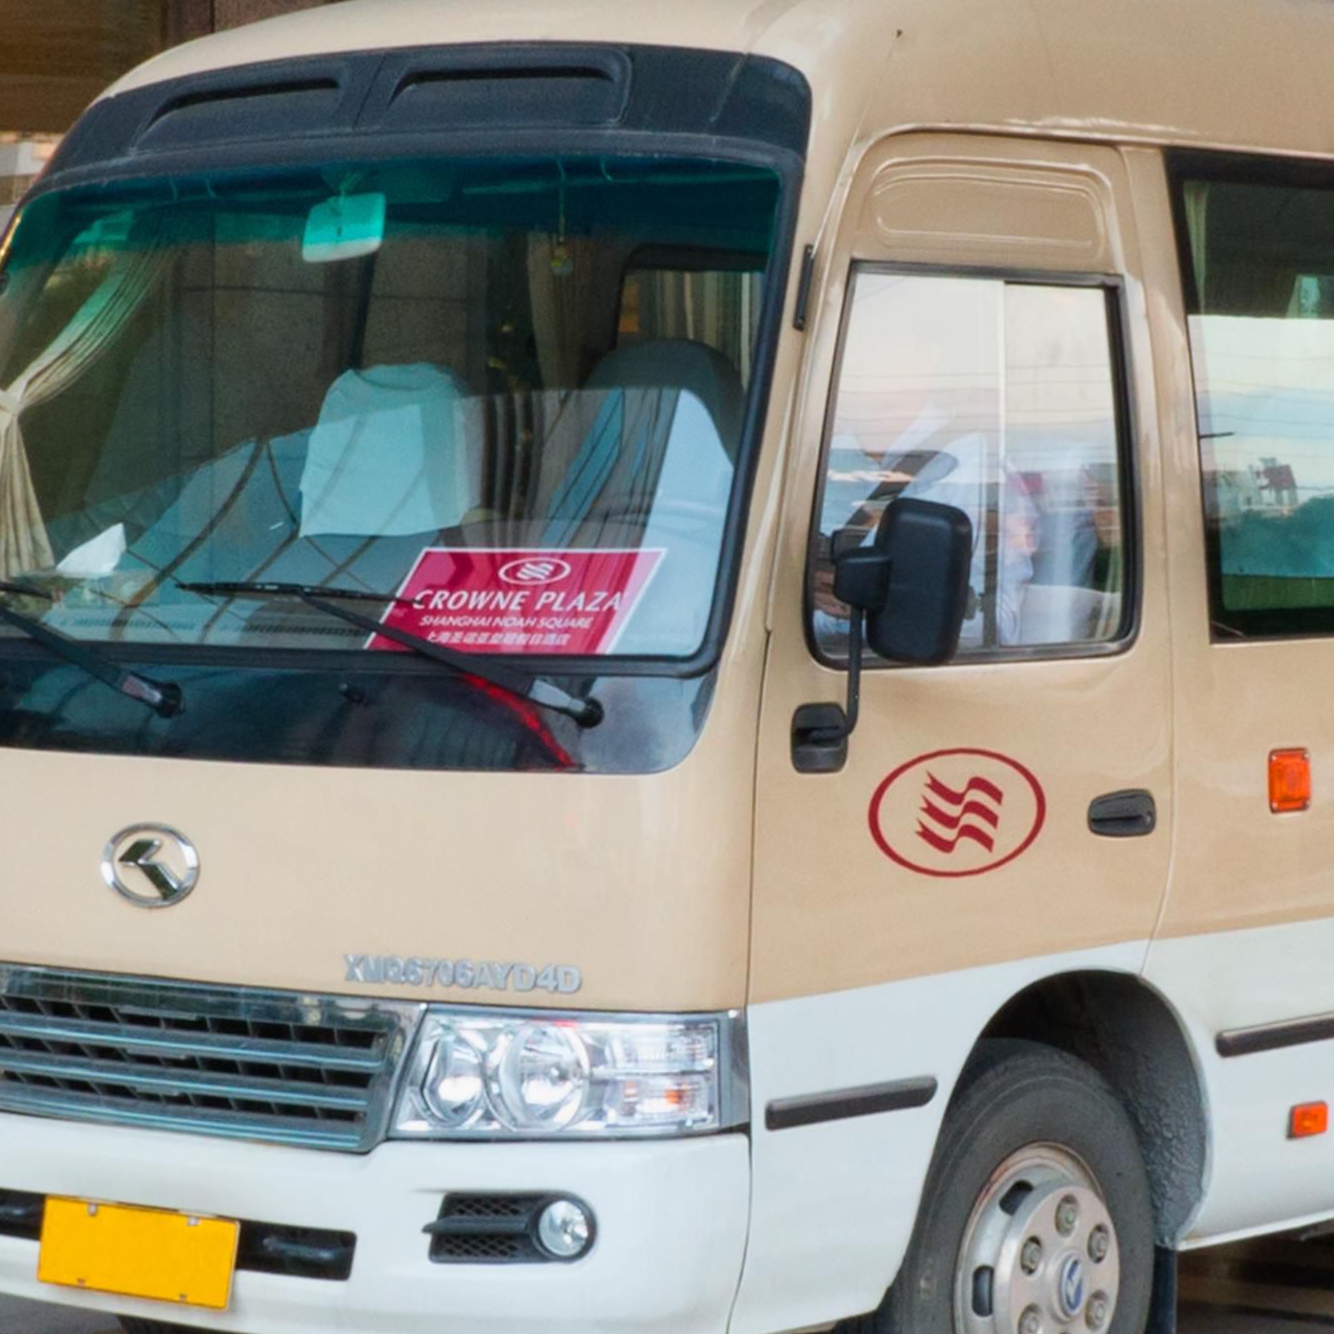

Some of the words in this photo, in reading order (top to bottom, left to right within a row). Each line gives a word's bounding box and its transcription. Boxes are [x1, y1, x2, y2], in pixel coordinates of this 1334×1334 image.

[412, 589, 530, 611] CROWNE
[536, 590, 623, 612] PLAZA
[419, 615, 492, 628] SHANGHAI
[494, 615, 536, 628] NOAH
[539, 616, 594, 629] SQUARE
